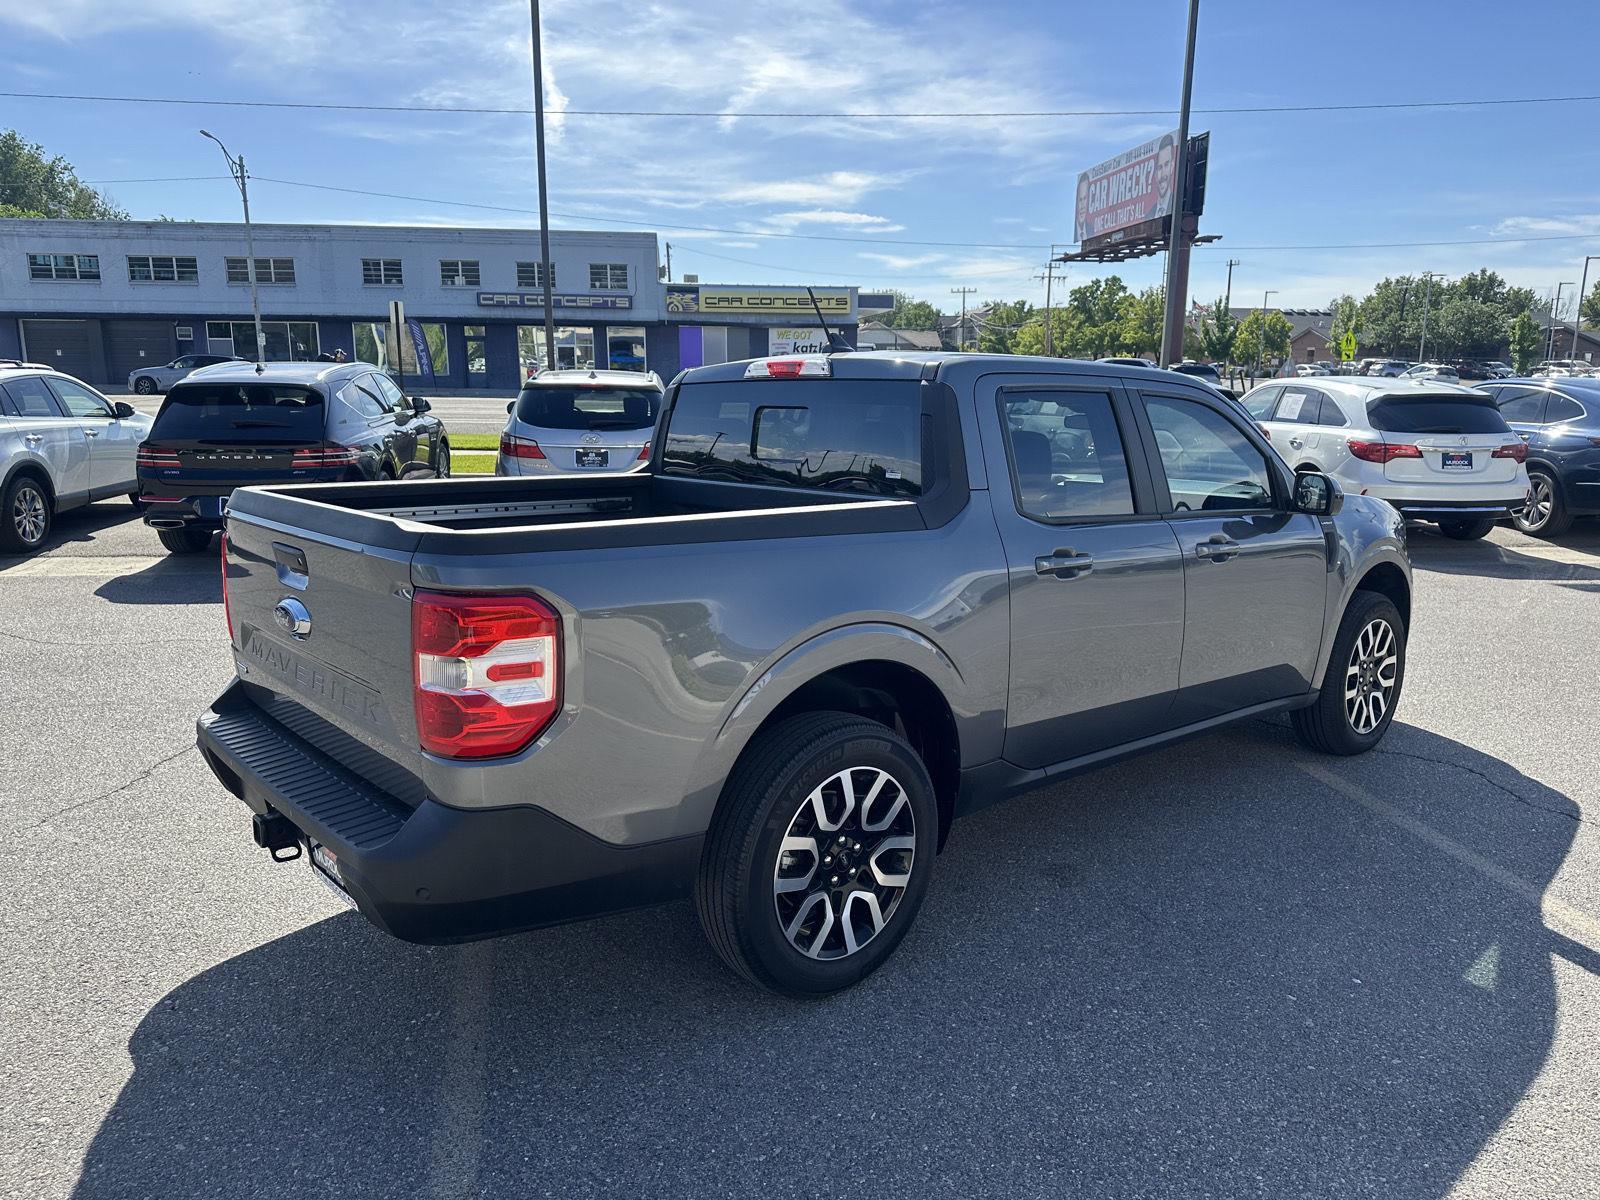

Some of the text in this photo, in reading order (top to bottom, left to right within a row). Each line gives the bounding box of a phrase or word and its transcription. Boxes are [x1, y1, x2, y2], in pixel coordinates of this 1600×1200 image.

[1088, 180, 1108, 214] CAR
[1108, 159, 1155, 207] WRECK?
[1134, 201, 1145, 220] ALL
[480, 294, 520, 305] CAR
[704, 297, 848, 306] CAR CONCEPTS
[777, 330, 813, 340] WE GOT
[792, 341, 823, 354] katz
[251, 636, 382, 723] MAVERICK
